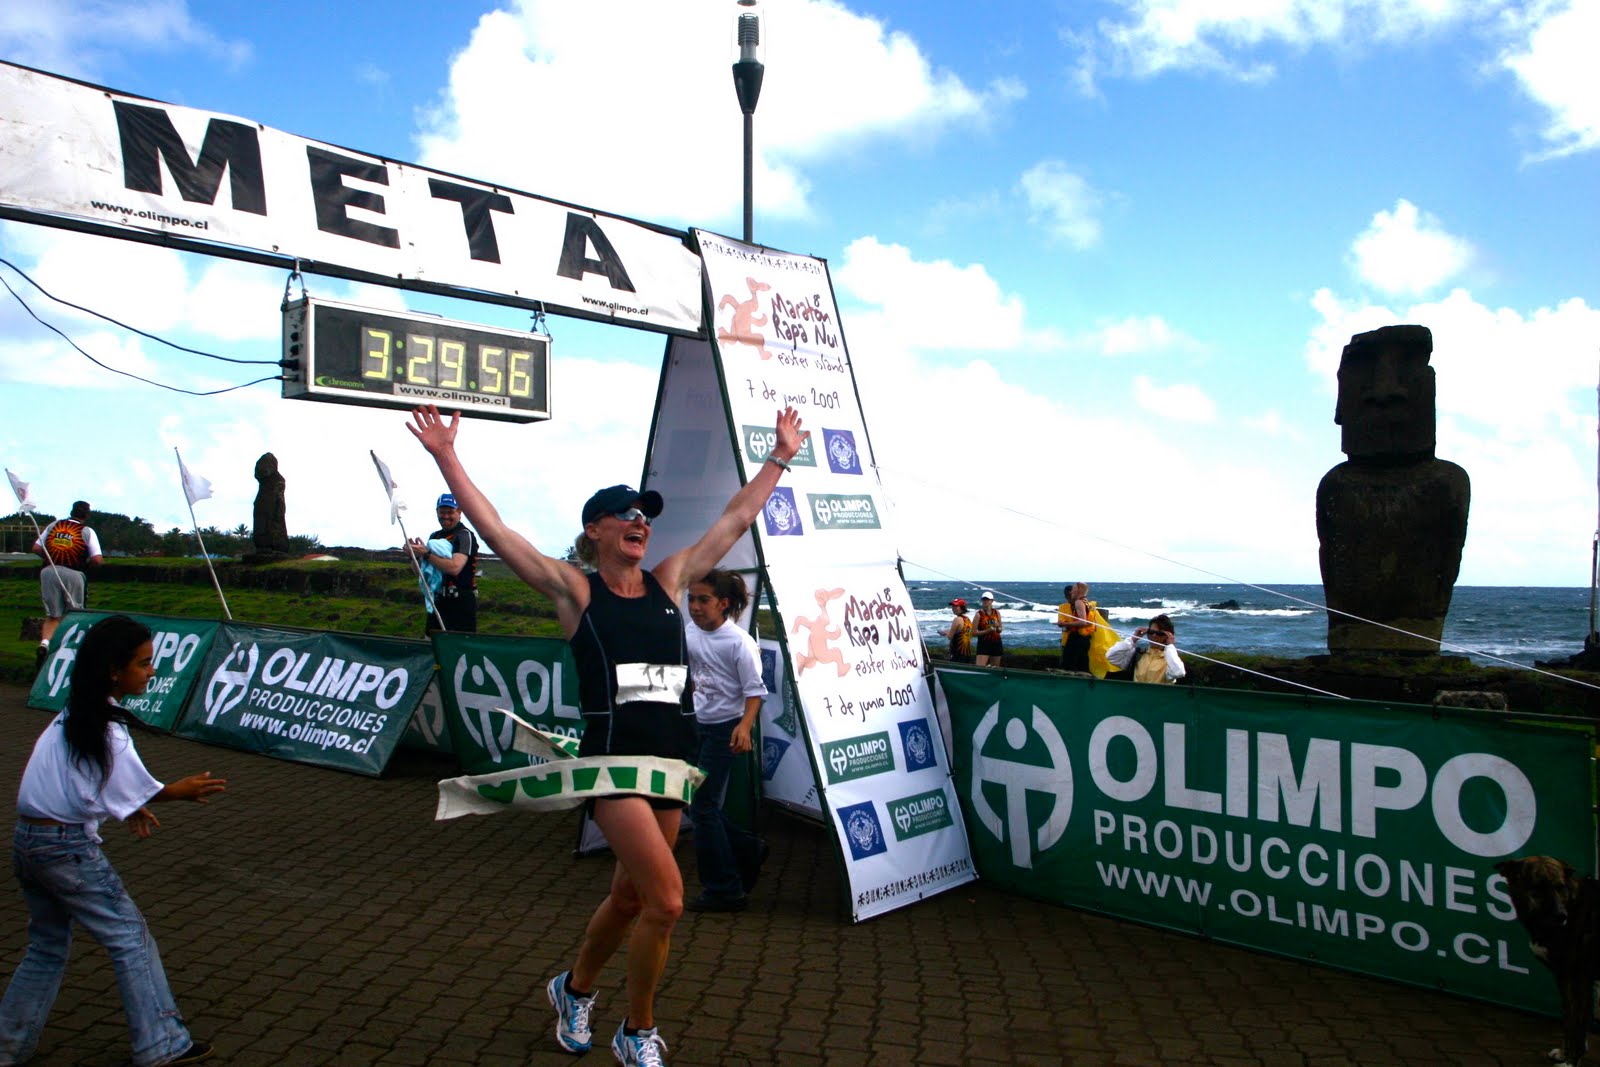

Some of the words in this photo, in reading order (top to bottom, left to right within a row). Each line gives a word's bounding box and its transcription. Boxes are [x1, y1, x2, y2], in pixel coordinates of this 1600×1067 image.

[112, 99, 637, 293] META
[90, 200, 208, 230] www.olimpo.cl
[582, 296, 649, 316] www.olimpo.cl
[772, 312, 808, 350] Rapa
[815, 322, 838, 348] Nui
[778, 349, 808, 369] easter
[815, 354, 844, 373] island
[399, 386, 507, 406] www.olimpo.cl
[746, 379, 755, 398] 7
[762, 380, 776, 402] de
[811, 387, 841, 409] 2009
[830, 499, 871, 513] OLIMPO
[56, 532, 74, 540] TEAM
[844, 618, 880, 654] Rapa
[888, 616, 914, 644] Nui
[855, 654, 885, 677] easter
[891, 649, 918, 670] island
[261, 647, 409, 710] OLIMPO
[248, 688, 388, 734] PRODUCCIONES
[823, 697, 832, 717] 7
[839, 694, 854, 715] de
[859, 697, 885, 722] junio
[887, 684, 916, 706] 2009
[239, 711, 376, 755] www.olimpo.cl
[846, 738, 887, 759] OLIMPO
[849, 752, 888, 767] PRODUCCIONES
[1088, 715, 1537, 858] OLIMPO
[908, 795, 944, 816] OLIMPO
[1094, 809, 1518, 921] PRODUCCIONES
[1096, 861, 1530, 975] WWW.OLIMPO.CL
